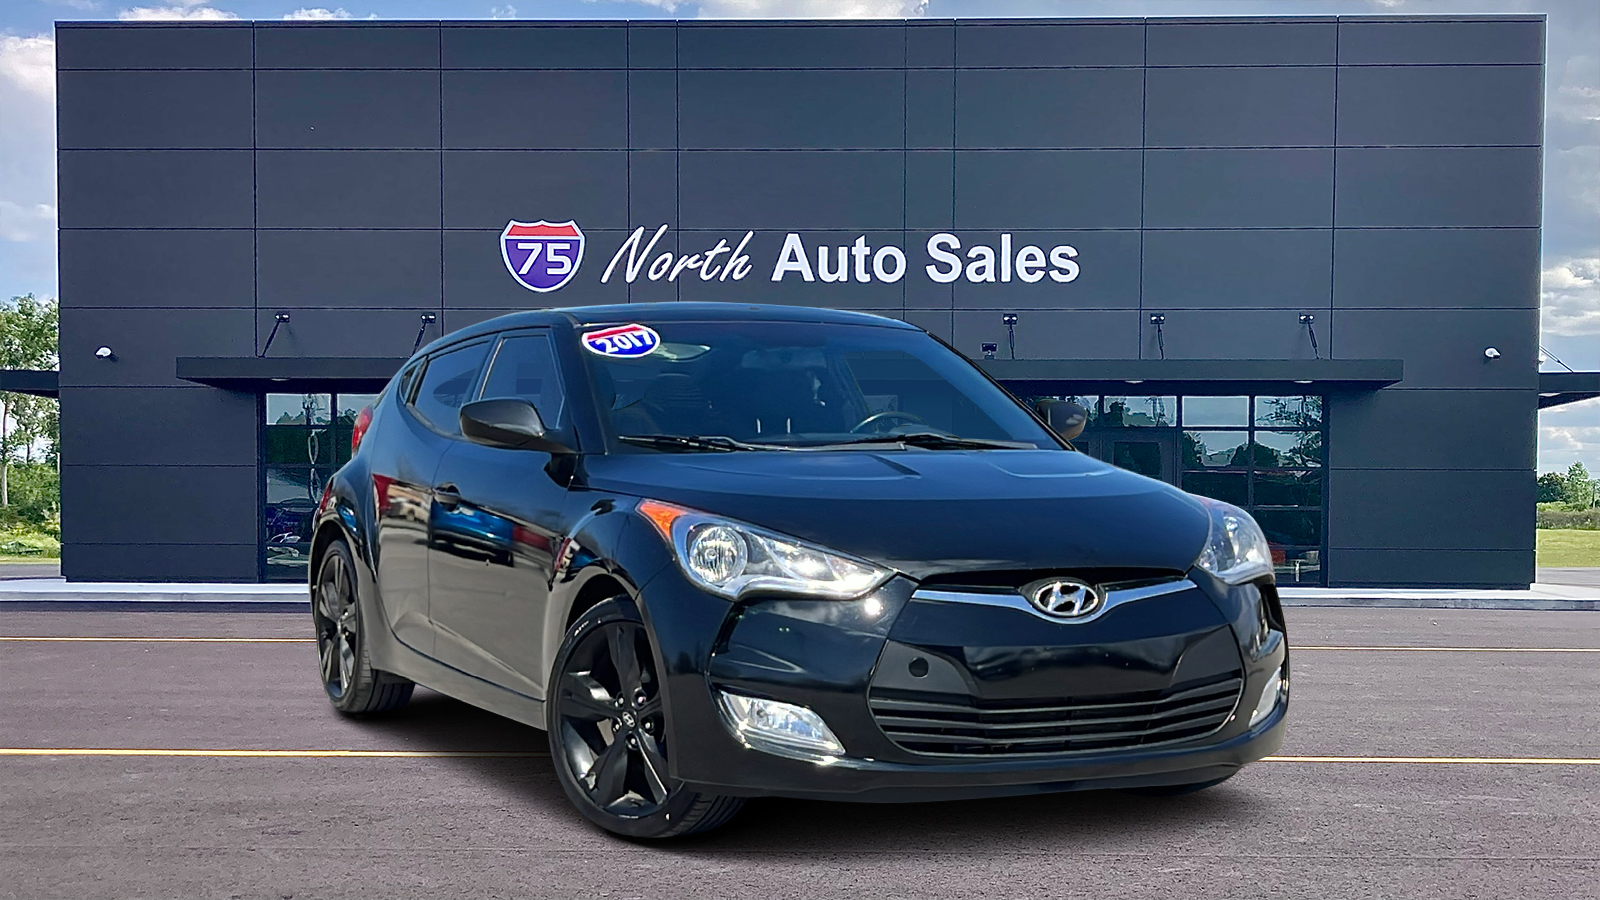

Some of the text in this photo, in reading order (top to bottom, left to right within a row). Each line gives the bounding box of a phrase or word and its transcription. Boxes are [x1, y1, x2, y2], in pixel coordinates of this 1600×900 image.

[517, 223, 1081, 284] 75 North Auto Sales
[595, 330, 653, 354] 2017
